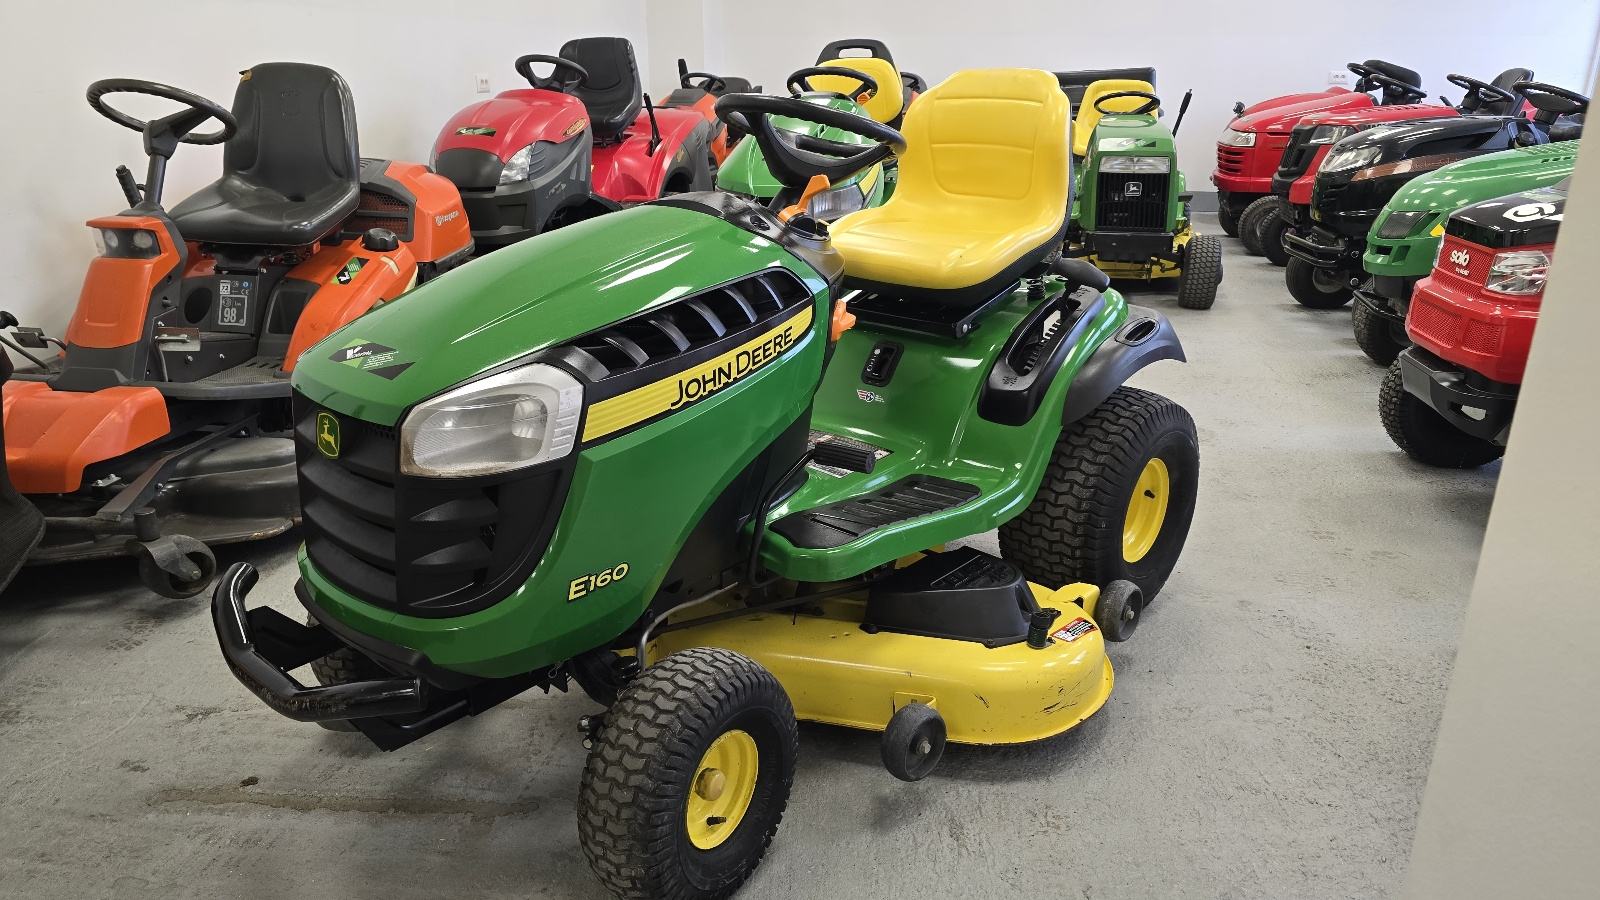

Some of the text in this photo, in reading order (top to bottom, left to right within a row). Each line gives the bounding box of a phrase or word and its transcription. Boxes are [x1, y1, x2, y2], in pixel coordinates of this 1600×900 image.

[1450, 249, 1470, 267] solo
[223, 307, 237, 323] 98
[670, 326, 793, 408] JOHN DEERE
[568, 562, 629, 601] E160
